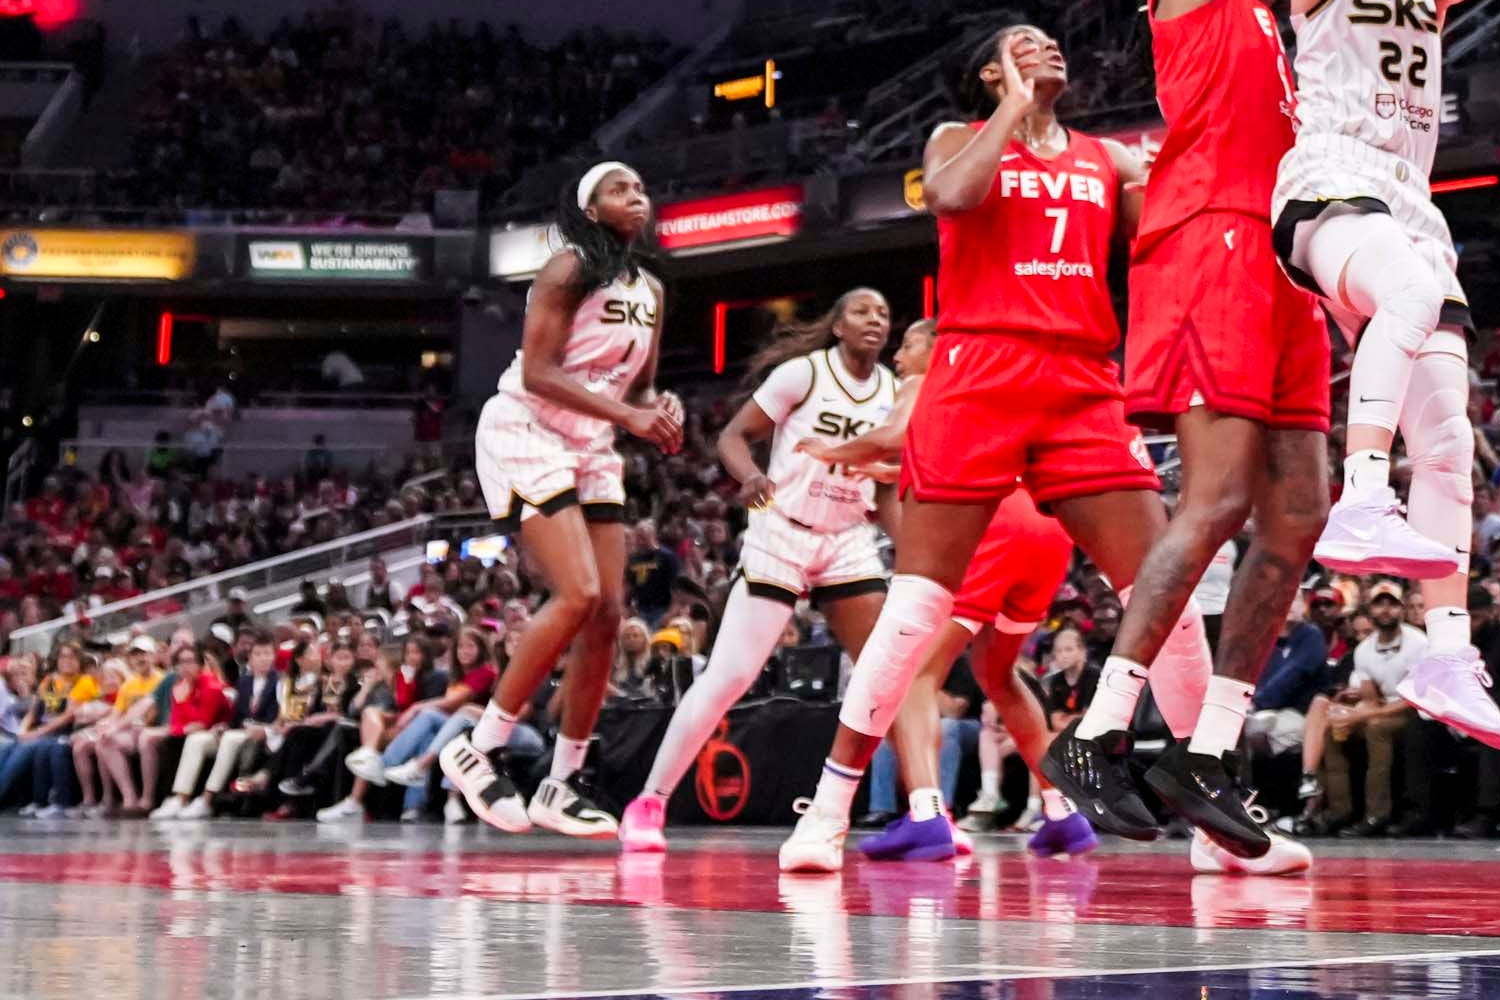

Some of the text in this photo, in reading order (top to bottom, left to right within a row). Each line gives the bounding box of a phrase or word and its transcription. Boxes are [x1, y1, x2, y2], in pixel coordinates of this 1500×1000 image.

[1379, 40, 1428, 88] 22
[1000, 169, 1105, 209] FEVER
[1045, 207, 1069, 254] 7
[1014, 259, 1093, 280] salesforce
[813, 411, 876, 440] SK
